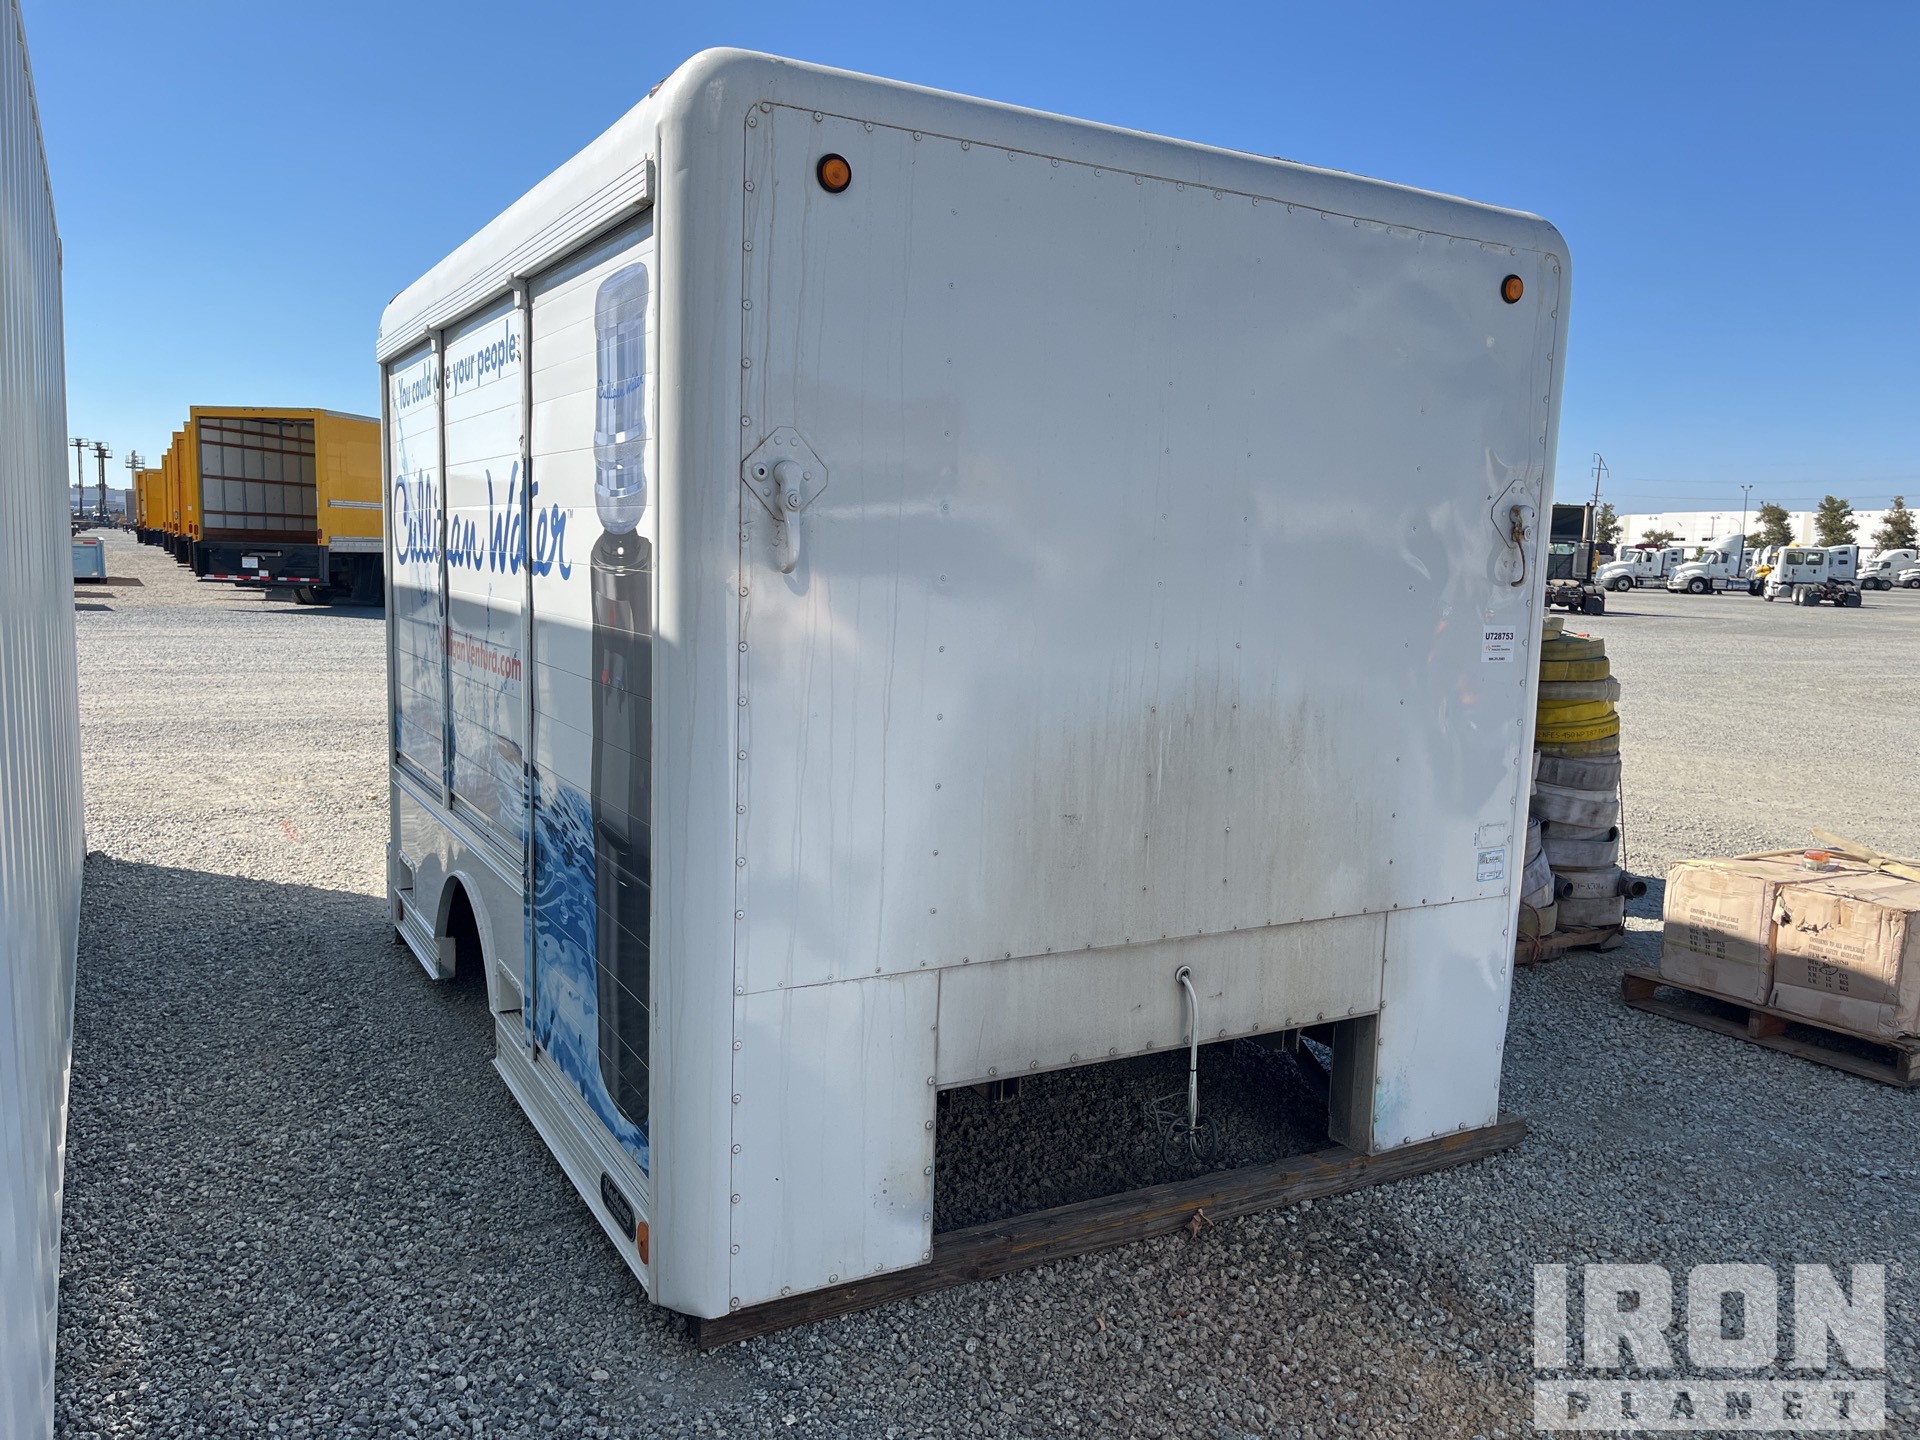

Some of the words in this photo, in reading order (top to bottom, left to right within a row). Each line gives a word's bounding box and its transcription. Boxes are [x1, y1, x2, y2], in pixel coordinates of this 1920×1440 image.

[398, 377, 410, 409] You
[412, 359, 431, 403] could
[453, 354, 475, 397] your
[478, 319, 516, 387] people
[1485, 632, 1514, 640] U728753
